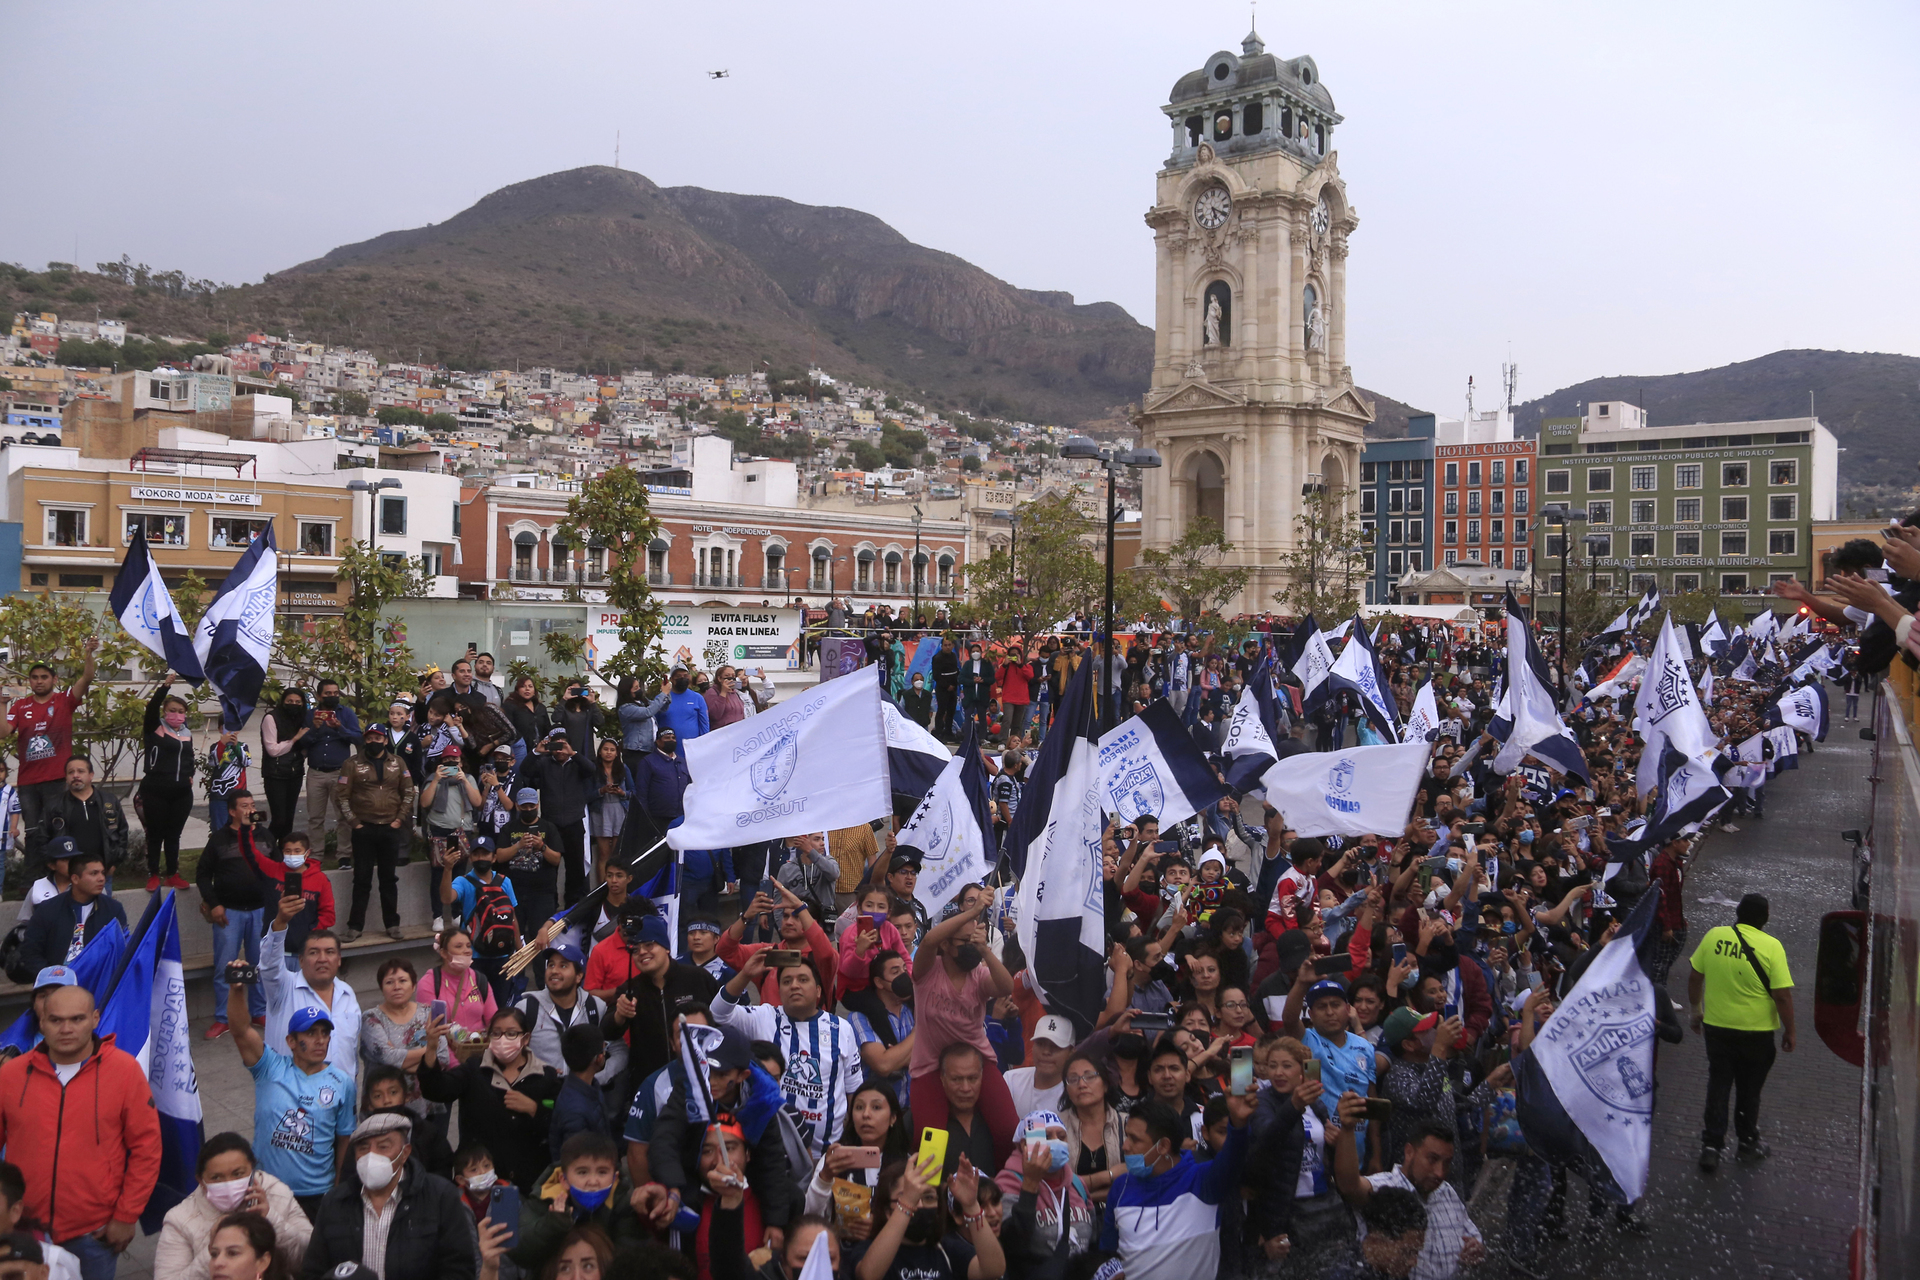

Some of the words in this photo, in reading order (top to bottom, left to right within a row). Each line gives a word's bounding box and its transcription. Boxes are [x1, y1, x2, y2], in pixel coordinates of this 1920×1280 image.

[1548, 423, 1577, 431] EDIFICIO
[1438, 445, 1481, 457] HOTEL
[1483, 442, 1523, 454] CIROS
[1562, 457, 1601, 465] INSTITUTO
[1616, 453, 1683, 463] ADMINISTRACION
[1685, 451, 1720, 459] PUBLICA
[1737, 449, 1775, 457] HIDALGO
[139, 488, 181, 499] KOKORO
[185, 491, 214, 501] MODA
[229, 493, 251, 503] CAFÉ
[693, 525, 714, 533] HOTEL
[722, 526, 771, 536] INDEPENDENCIA
[1590, 525, 1636, 533] SECRETARIA
[1623, 558, 1636, 567] DE
[1639, 558, 1653, 566] LA
[1655, 557, 1714, 567] TESORERIA
[1717, 557, 1774, 566] MUNICIPAL
[294, 592, 323, 600] OPTICA
[662, 615, 689, 627] 2022
[711, 613, 741, 623] ¡EVITA
[743, 614, 768, 623] FILAS
[770, 614, 777, 623] Y
[708, 627, 734, 636] PAGA
[735, 627, 748, 636] EN
[749, 627, 780, 636] LINEA!
[1715, 939, 1755, 961] STAF
[783, 1077, 824, 1092] CEMENTOS
[780, 1084, 824, 1099] FORTALEZA
[272, 1131, 313, 1147] CEMENTOS
[270, 1139, 314, 1155] FORTALEZA
